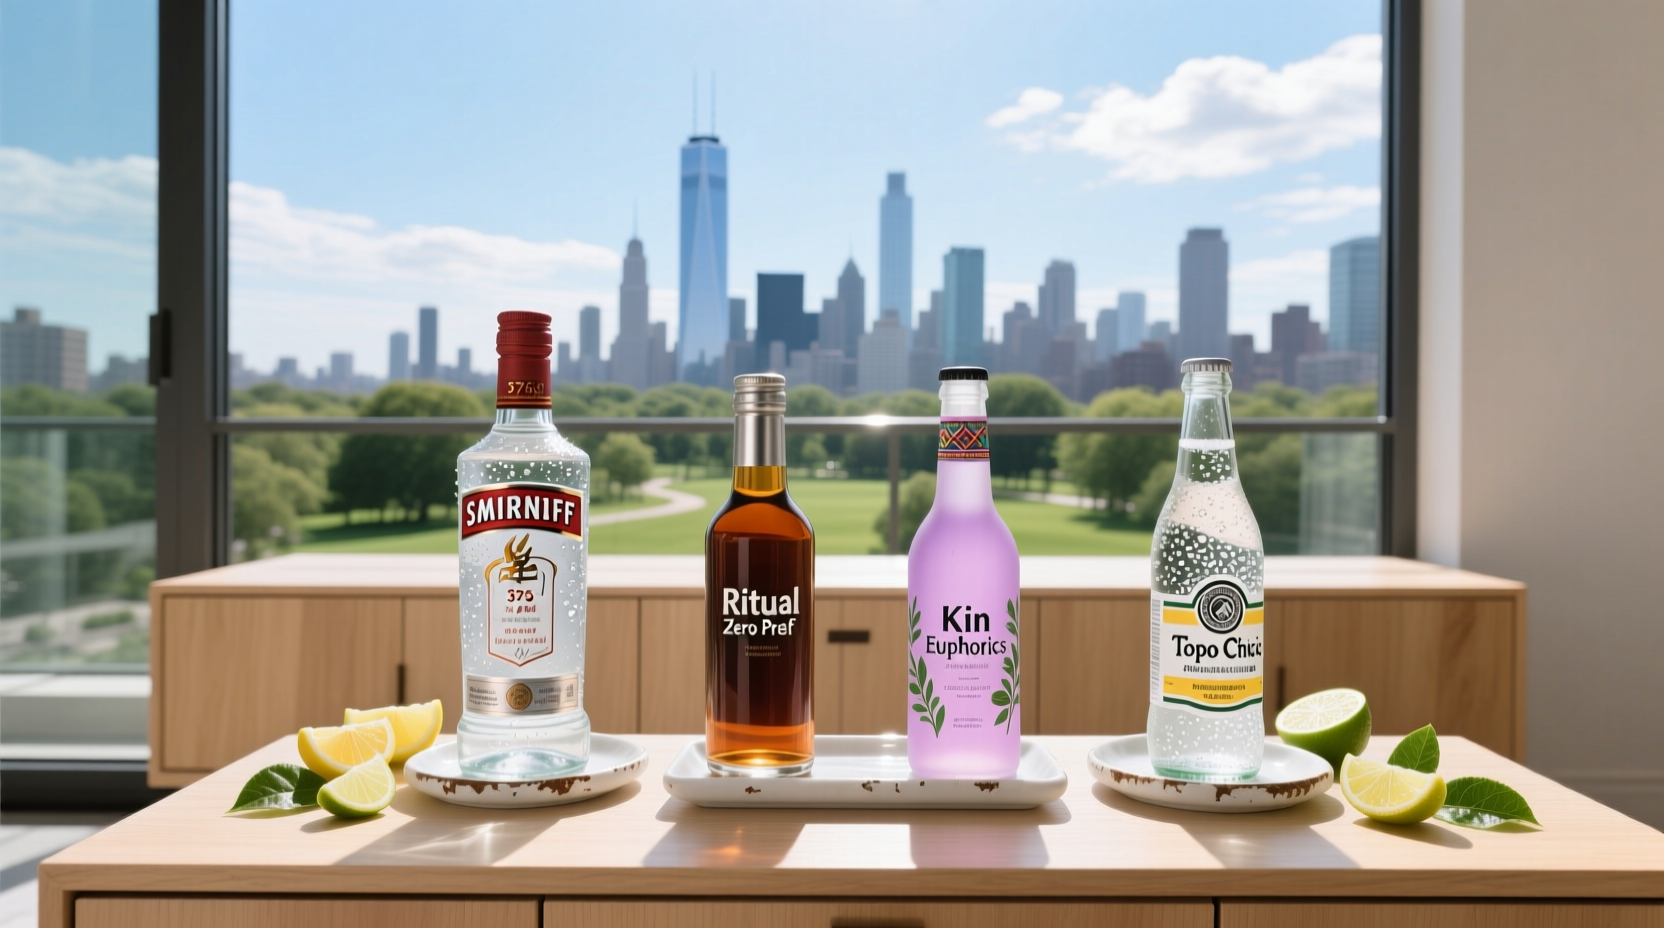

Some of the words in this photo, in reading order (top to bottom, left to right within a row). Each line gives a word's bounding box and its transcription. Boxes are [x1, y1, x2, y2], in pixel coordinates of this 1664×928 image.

[466, 495, 575, 527] SMIRNIFF
[722, 586, 800, 616] Ritual
[722, 618, 758, 636] Zero
[761, 618, 797, 636] Pref
[942, 605, 990, 633] Kin
[925, 635, 1007, 661] Euphorics
[1171, 634, 1219, 664] Topo
